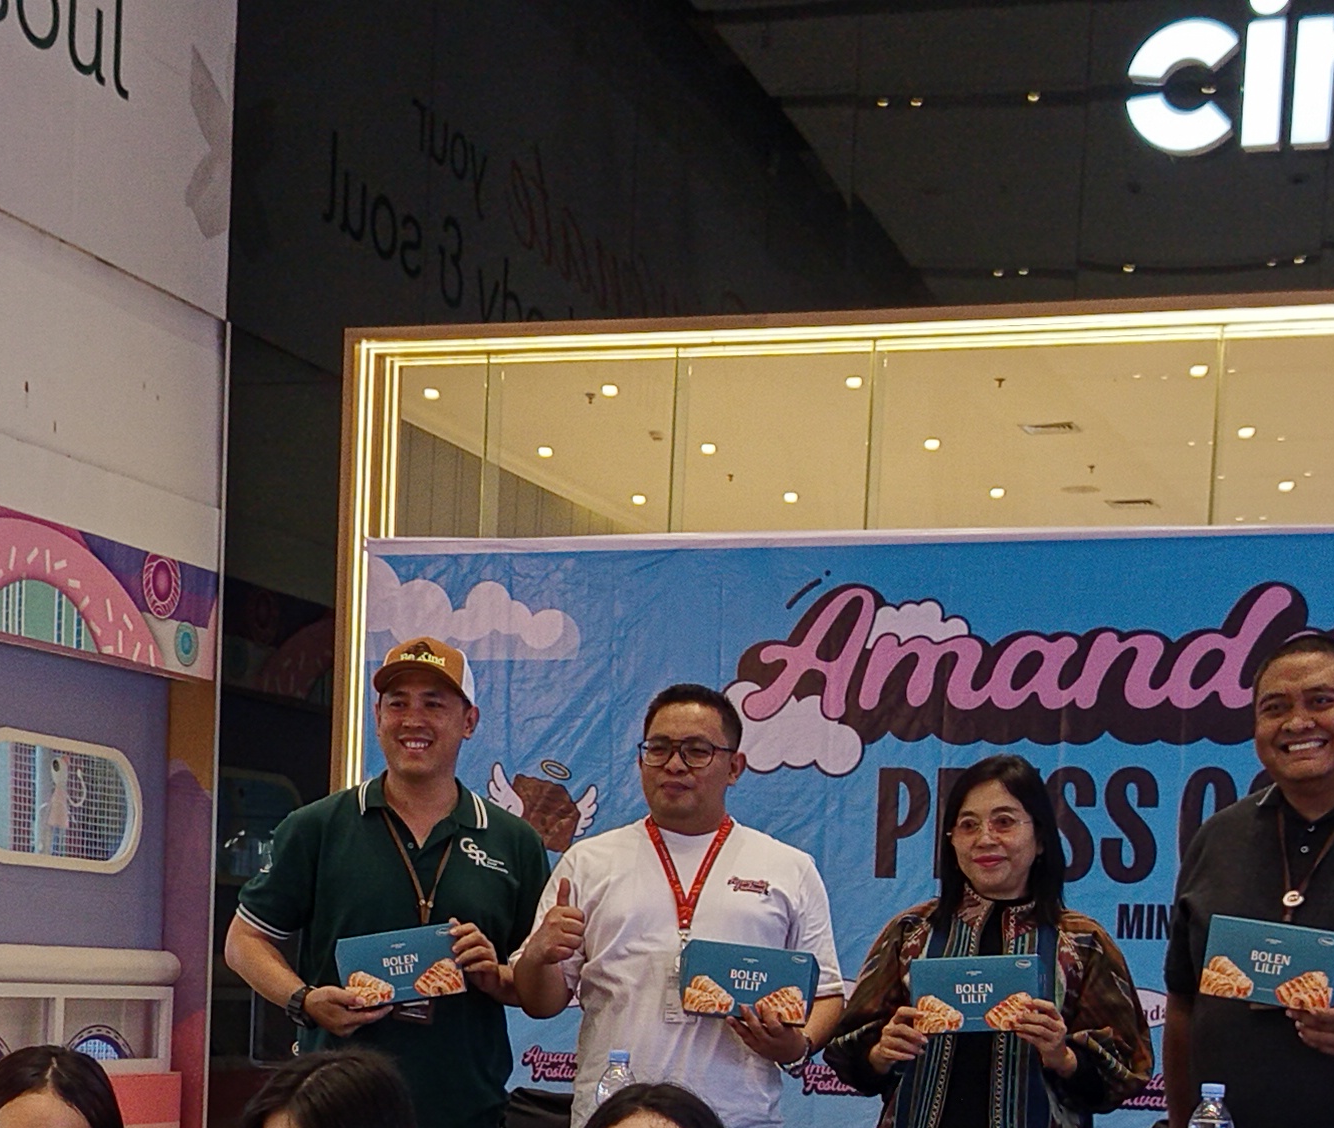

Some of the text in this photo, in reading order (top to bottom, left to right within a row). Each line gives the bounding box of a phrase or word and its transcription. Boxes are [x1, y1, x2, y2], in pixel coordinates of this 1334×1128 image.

[874, 766, 1159, 885] PSS
[460, 837, 488, 866] CSR
[382, 953, 419, 968] BOLEN
[1250, 950, 1292, 967] BOLEN
[389, 963, 415, 976] LILIT
[730, 968, 768, 983] BOLEN
[1254, 961, 1283, 976] LILIT
[734, 979, 761, 992] LILIT
[955, 982, 994, 995] BOLEN
[961, 993, 988, 1005] LILIT
